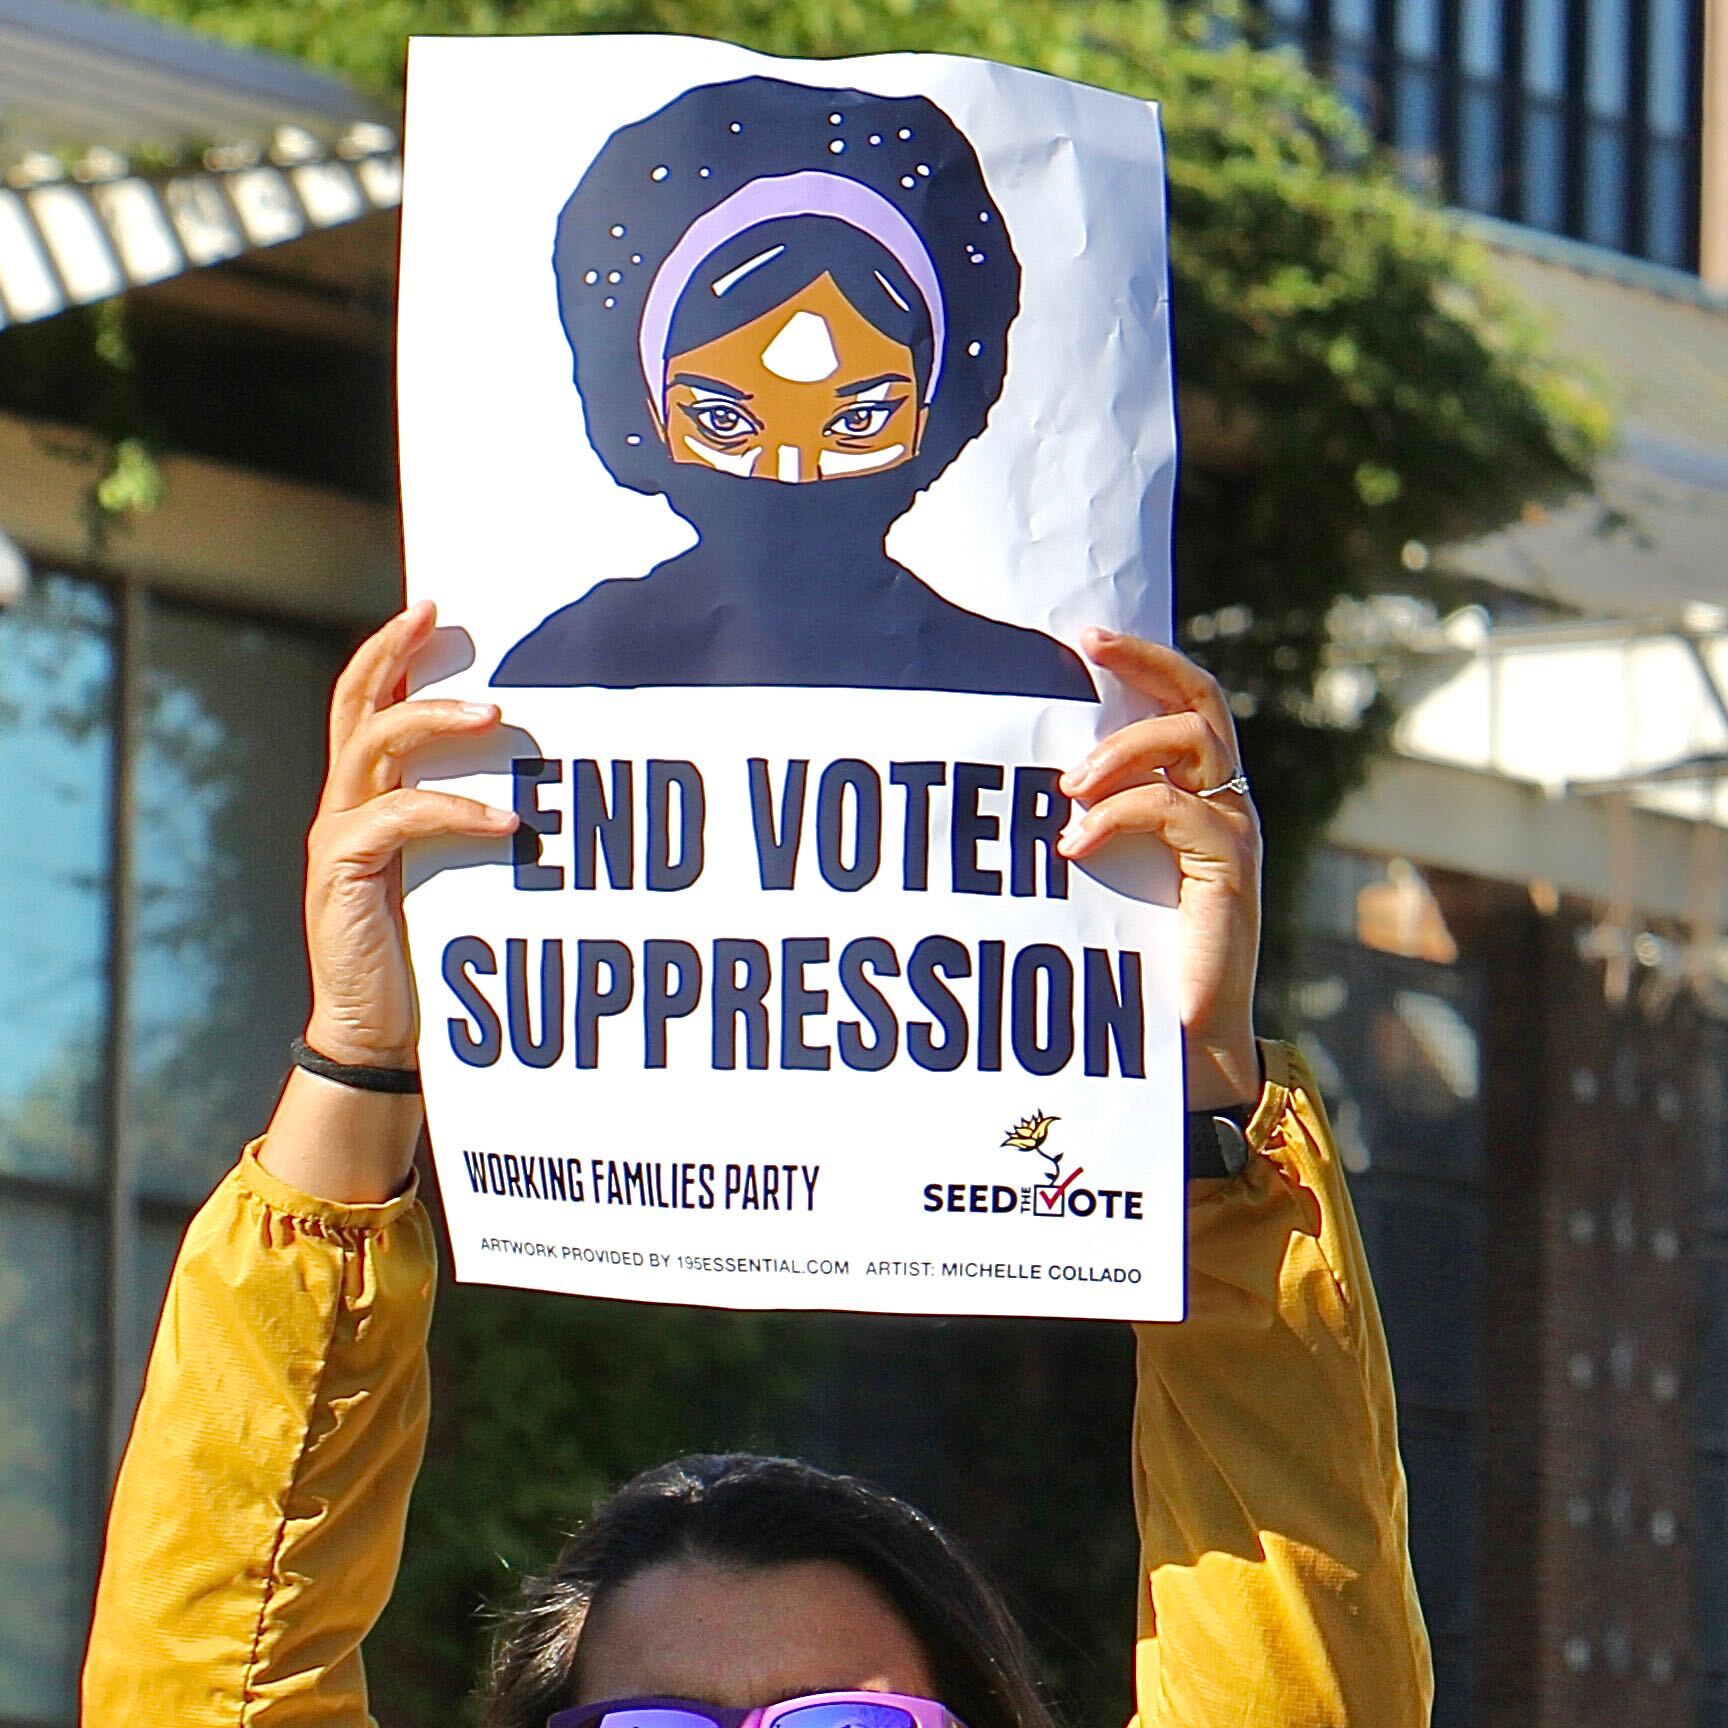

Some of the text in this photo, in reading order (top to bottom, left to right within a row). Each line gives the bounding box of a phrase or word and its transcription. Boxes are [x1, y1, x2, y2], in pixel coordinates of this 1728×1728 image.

[511, 757, 1072, 900] END VOTER
[441, 934, 1148, 1081] SUPPRESSION
[463, 1150, 820, 1211] WORKING FAMILIES PARTY
[923, 1183, 1018, 1214] SEED
[481, 1237, 1142, 1283] ARTWORK PROVIDED BY 195ESSENTIAL.COM ARTIST: MICHELLE COLLADO
